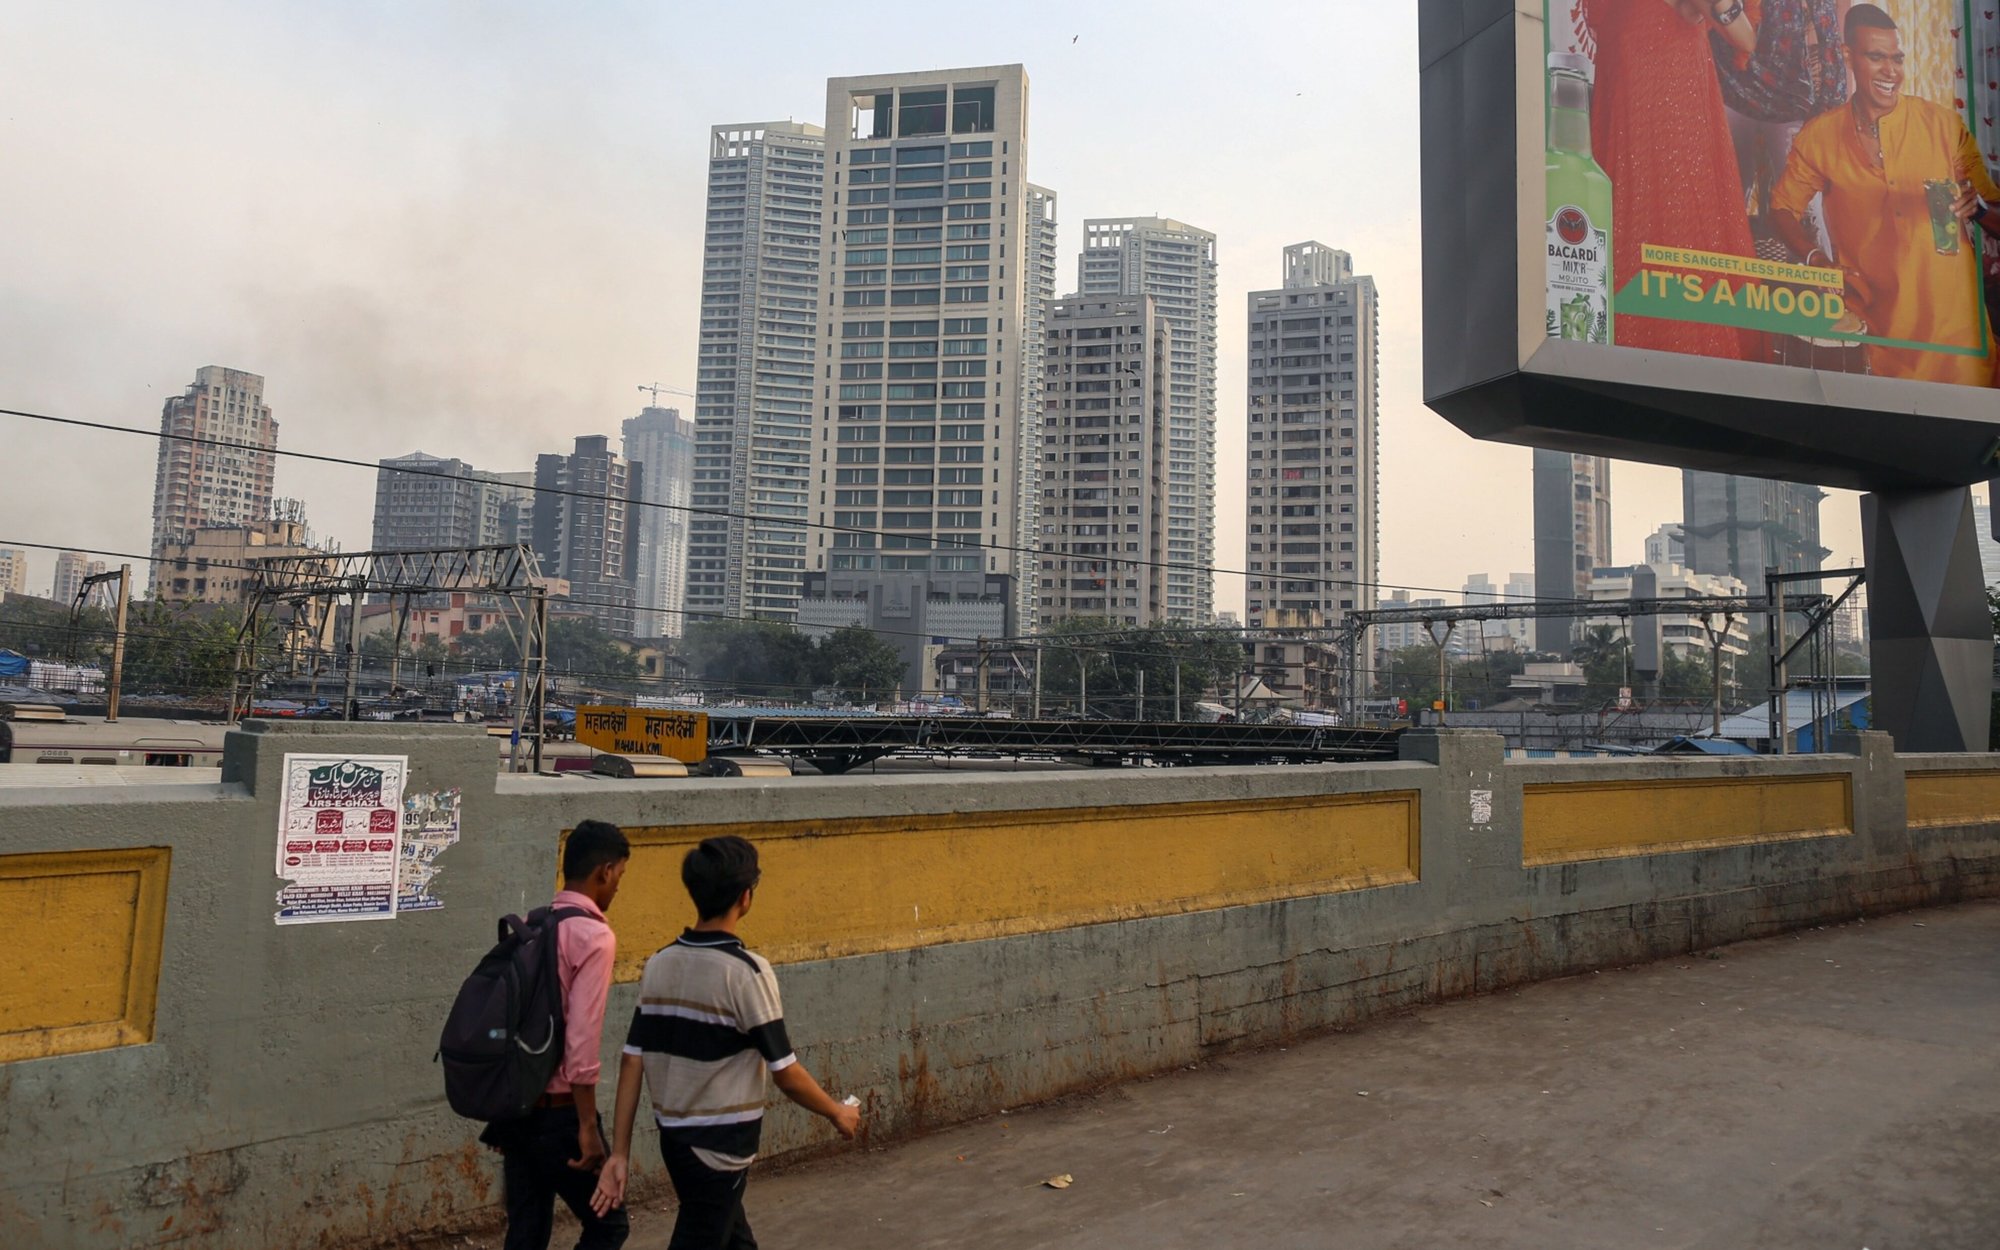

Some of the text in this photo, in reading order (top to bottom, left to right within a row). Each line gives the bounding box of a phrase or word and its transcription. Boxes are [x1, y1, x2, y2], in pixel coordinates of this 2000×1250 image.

[1548, 244, 1597, 262] BACARDÍ
[1645, 248, 1841, 284] MORE SANGEET, LESS PRACTICE.
[1558, 274, 1589, 285] MOJITO
[1641, 269, 1846, 320] IT'S A MOOD
[645, 714, 697, 740] महालक्ष्मी
[309, 799, 379, 807] URS-E-GHAZI
